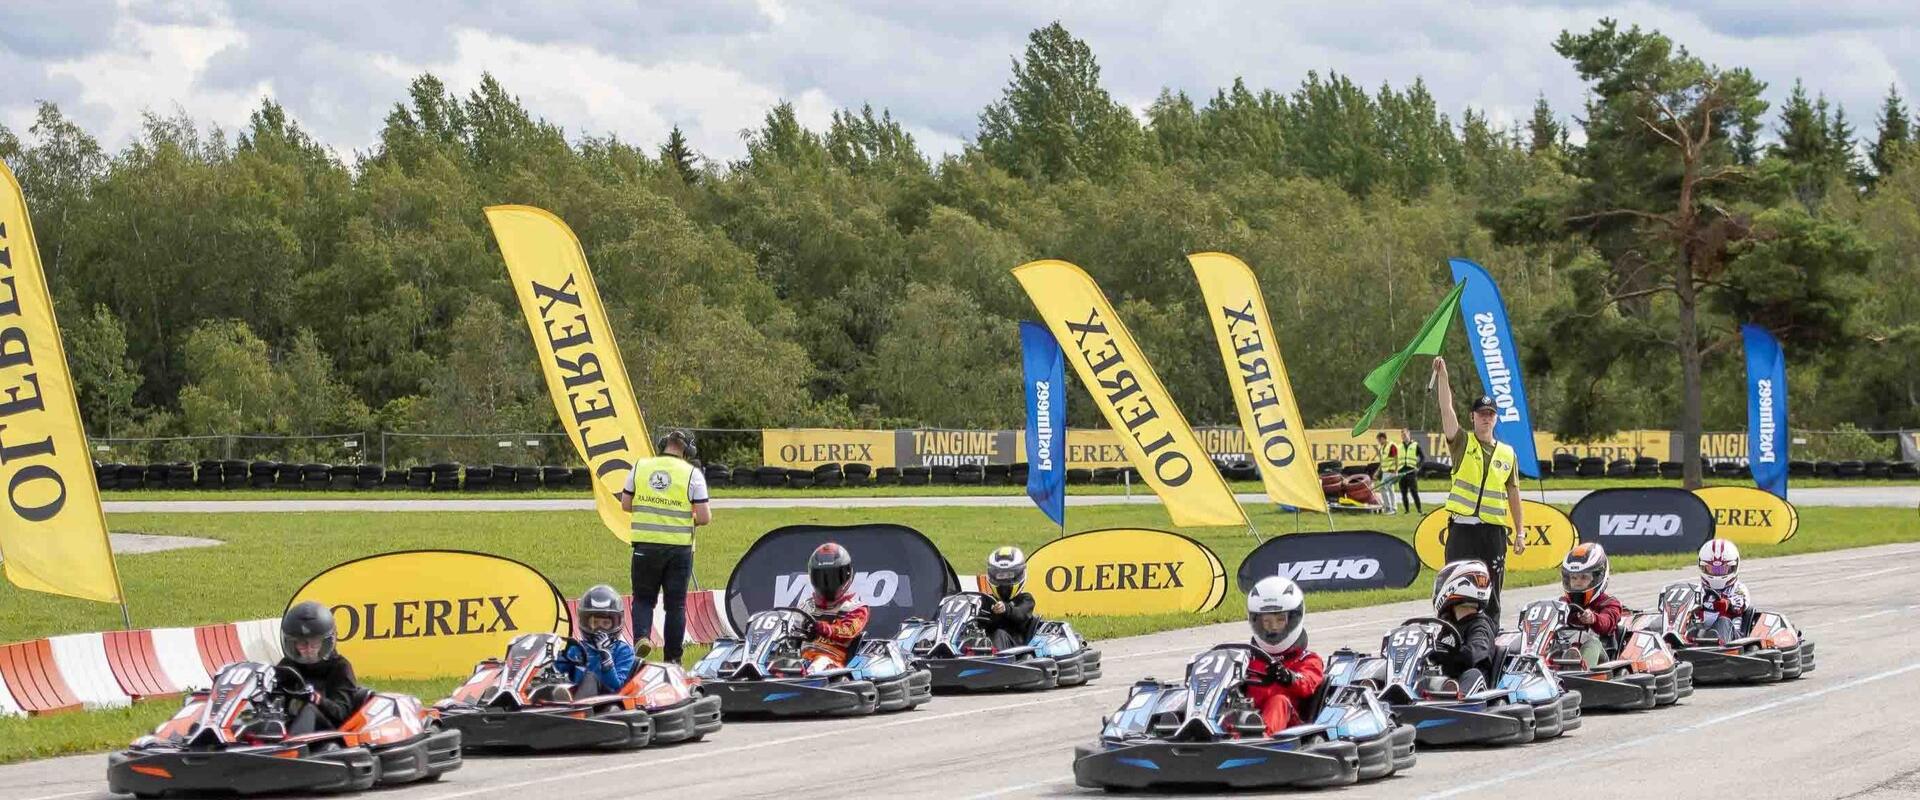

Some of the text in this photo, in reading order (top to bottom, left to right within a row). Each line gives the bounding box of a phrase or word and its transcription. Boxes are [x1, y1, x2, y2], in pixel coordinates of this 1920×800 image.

[780, 443, 873, 462] OLEREX
[912, 431, 998, 455] TANGIME
[1065, 444, 1128, 462] EREX
[1599, 513, 1681, 536] VEHO
[1714, 508, 1772, 527] EREX
[1045, 562, 1184, 592] OLEREX
[1277, 558, 1380, 581] VEHO
[331, 595, 520, 643] OLEREX
[754, 614, 779, 630] 16
[1527, 606, 1552, 620] 81
[1392, 631, 1421, 646] 55
[1195, 655, 1226, 675] 21
